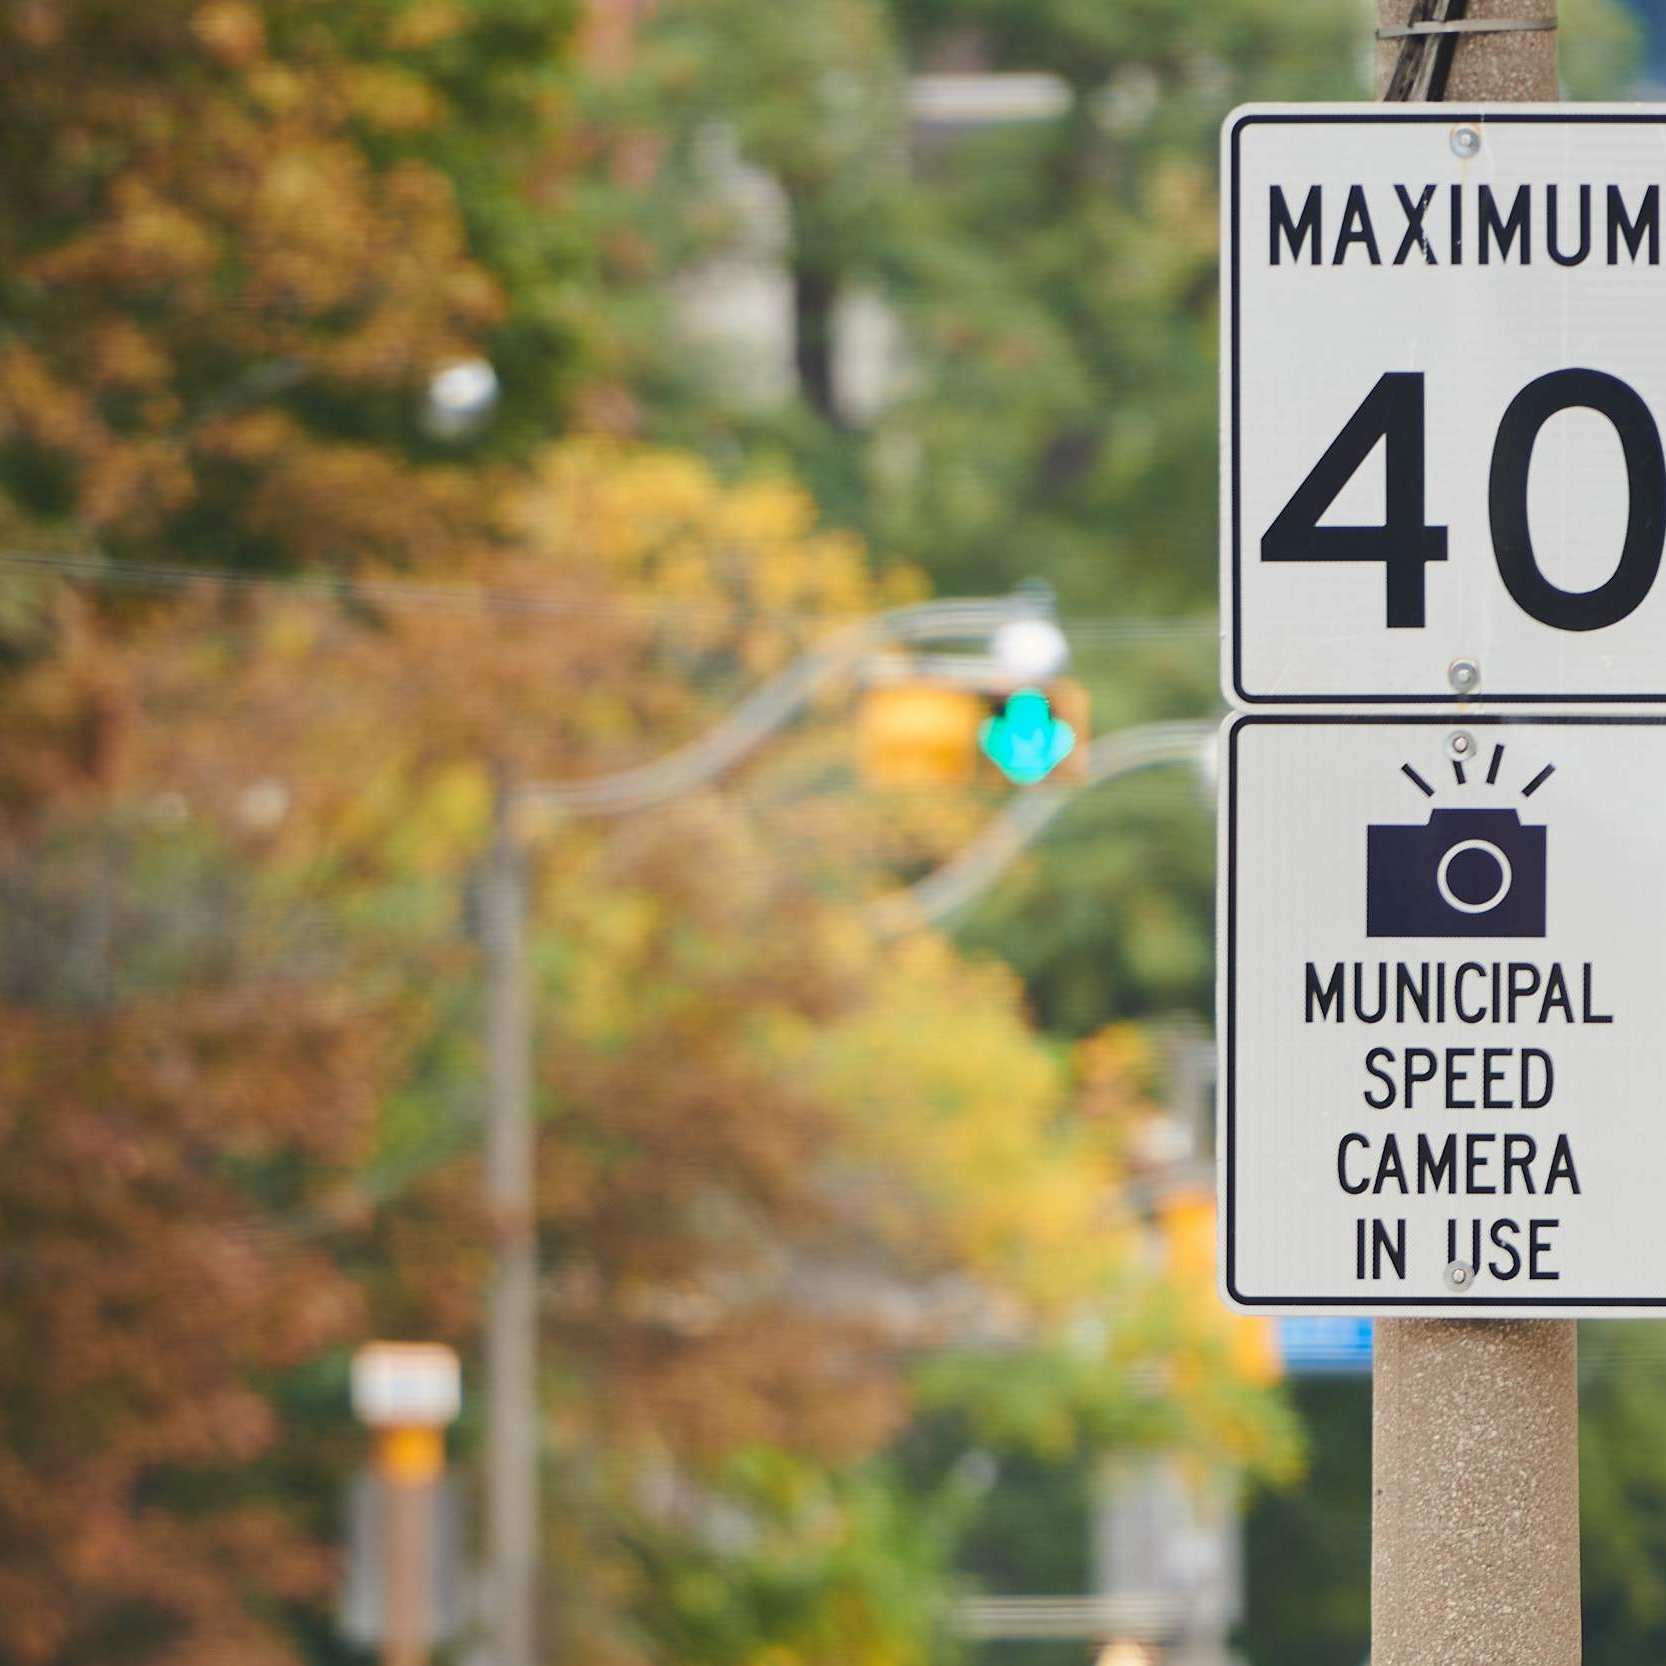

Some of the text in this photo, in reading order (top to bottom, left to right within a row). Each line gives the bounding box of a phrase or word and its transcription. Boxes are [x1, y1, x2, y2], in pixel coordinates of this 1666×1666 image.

[1269, 184, 1661, 267] MAXIMUM
[1305, 961, 1614, 1024] MUNICIPAL
[1363, 1046, 1555, 1110] SPEED
[1337, 1132, 1581, 1196] CAMERA
[1356, 1218, 1561, 1281] IN USE
